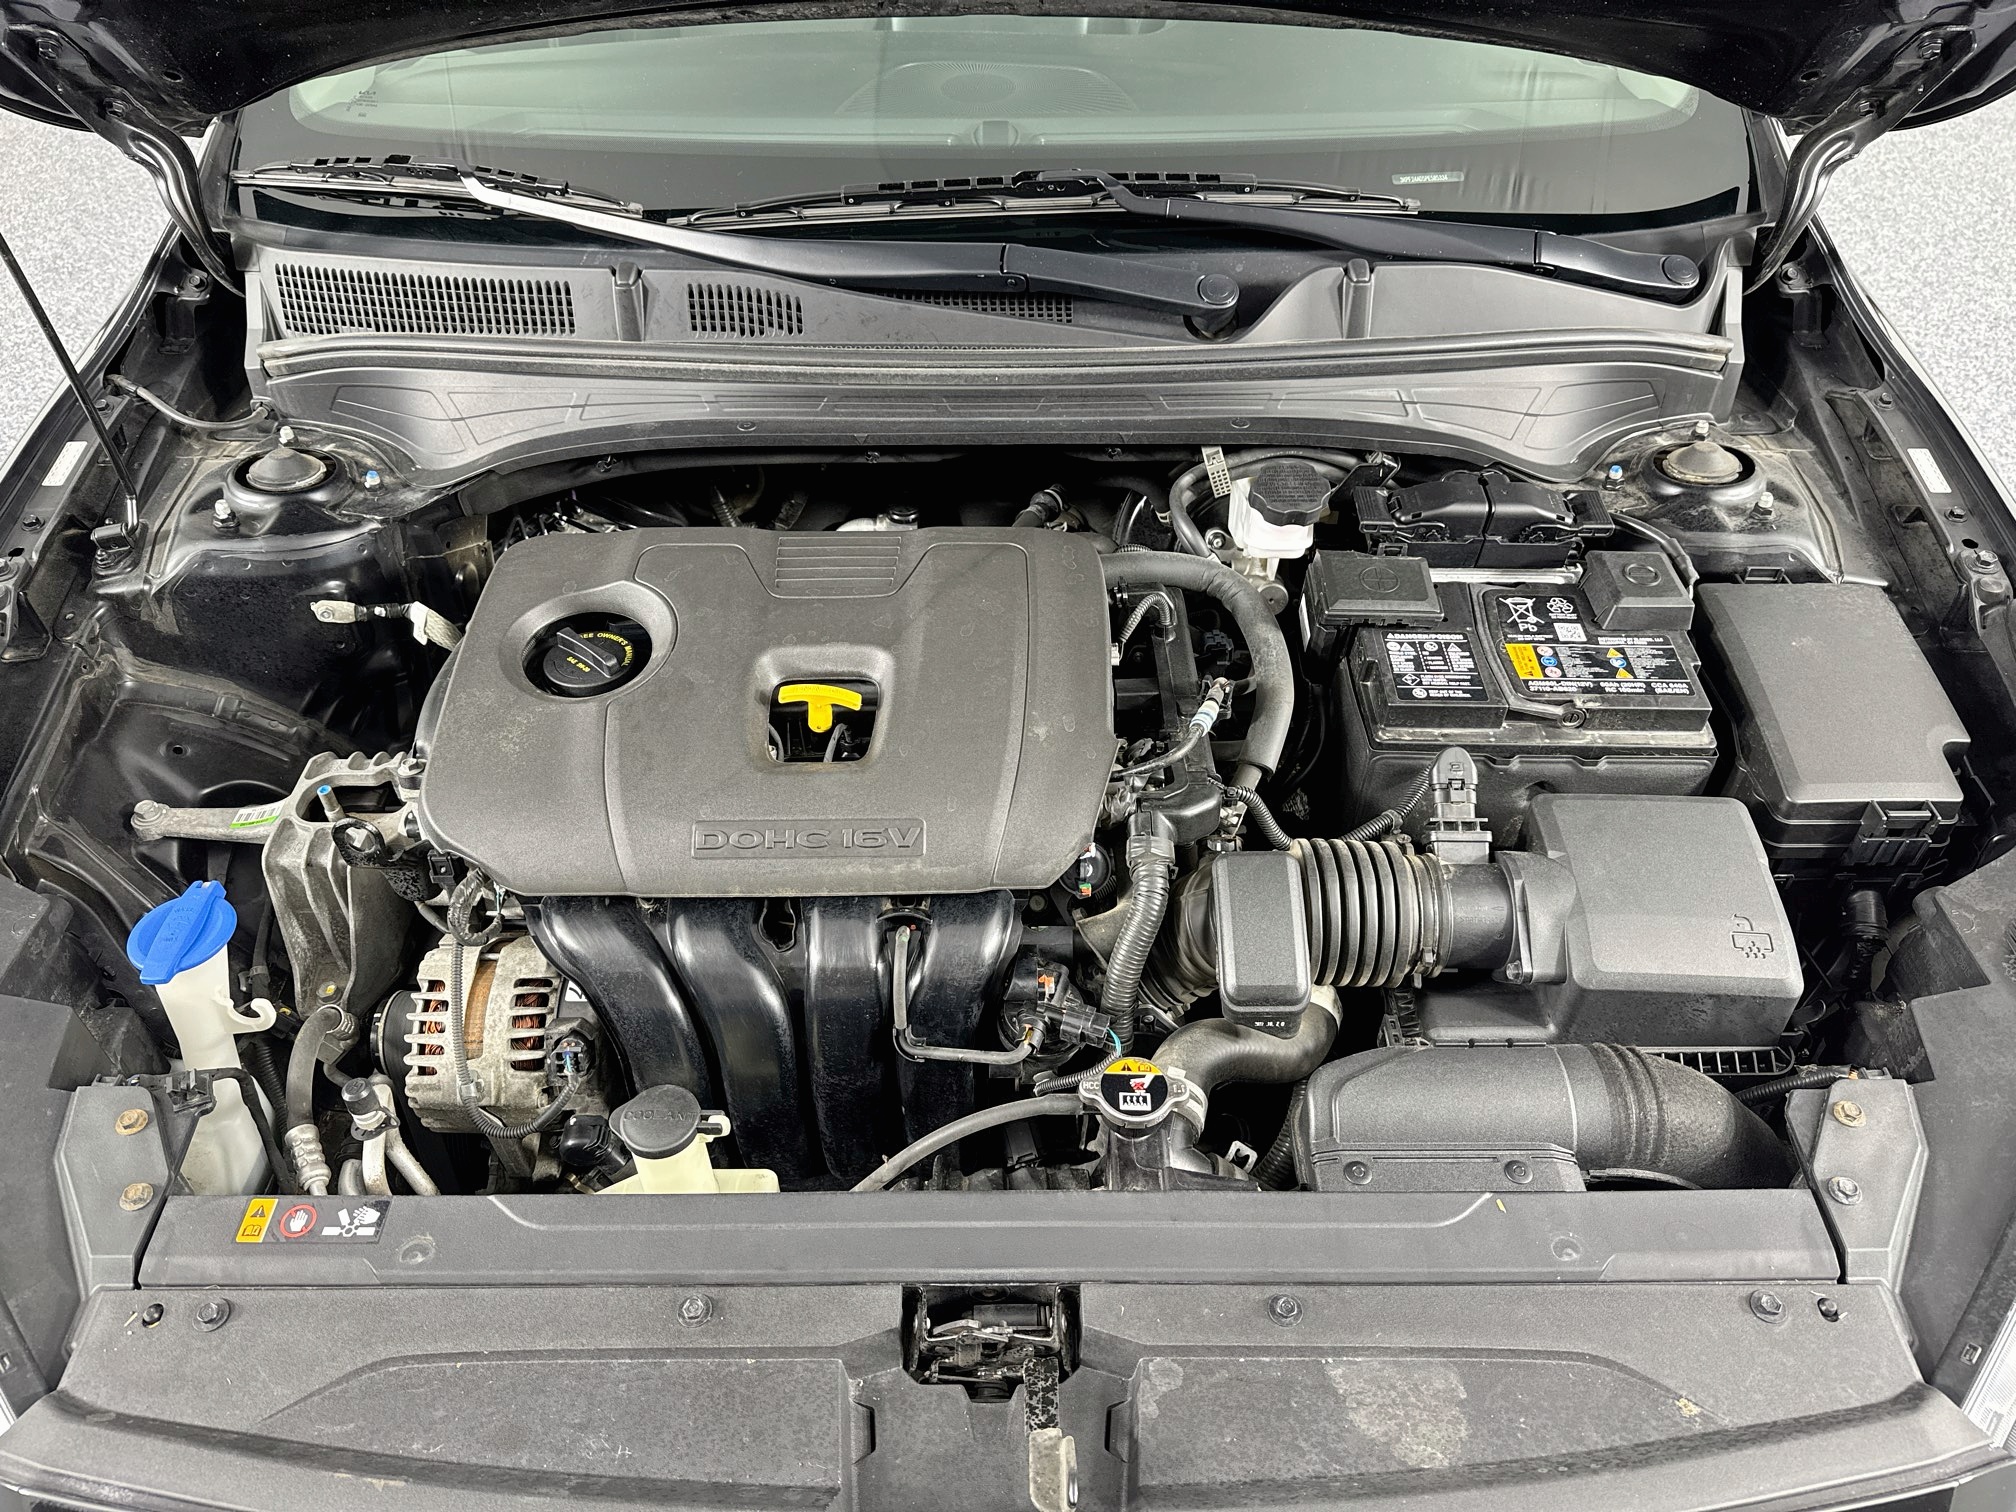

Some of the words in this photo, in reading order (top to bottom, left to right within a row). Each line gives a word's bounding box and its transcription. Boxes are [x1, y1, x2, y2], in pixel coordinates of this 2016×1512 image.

[1518, 623, 1538, 632] Pb
[596, 632, 629, 646] OWNER'S
[695, 828, 831, 850] DOHC
[841, 827, 922, 849] 16V
[1082, 1081, 1100, 1090] HCC
[624, 1109, 697, 1121] COOLANT
